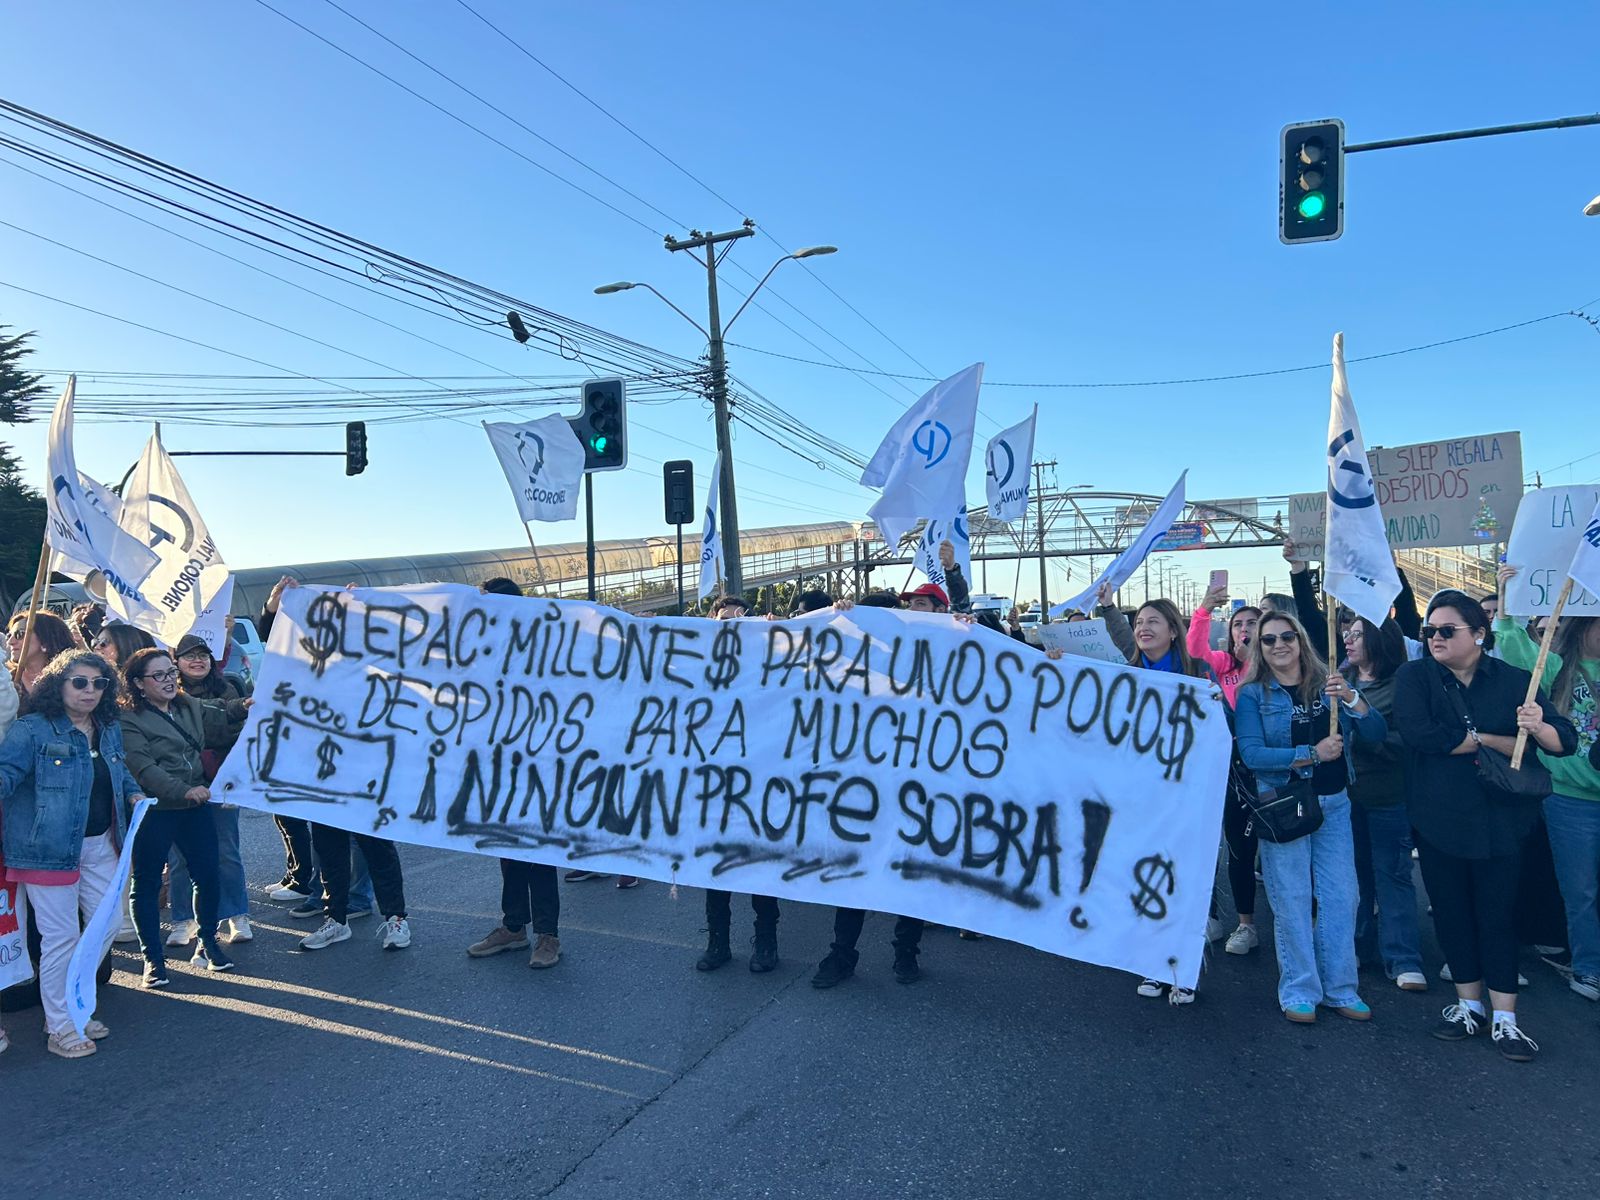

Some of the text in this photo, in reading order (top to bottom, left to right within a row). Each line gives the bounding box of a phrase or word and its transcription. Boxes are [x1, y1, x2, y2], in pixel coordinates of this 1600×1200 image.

[1397, 445, 1438, 473] SLEP
[1446, 438, 1504, 467] REGALA
[1378, 469, 1502, 506] DESPIDOS en
[1552, 494, 1575, 528] LA
[1301, 526, 1326, 538] PAR
[1530, 568, 1558, 607] SE
[1068, 625, 1098, 638] todas
[761, 625, 882, 697] PARA
[889, 637, 1023, 713] UNOS
[1030, 662, 1205, 781] POCO$
[625, 696, 746, 762] PARA
[784, 697, 1009, 779] MUCHOS
